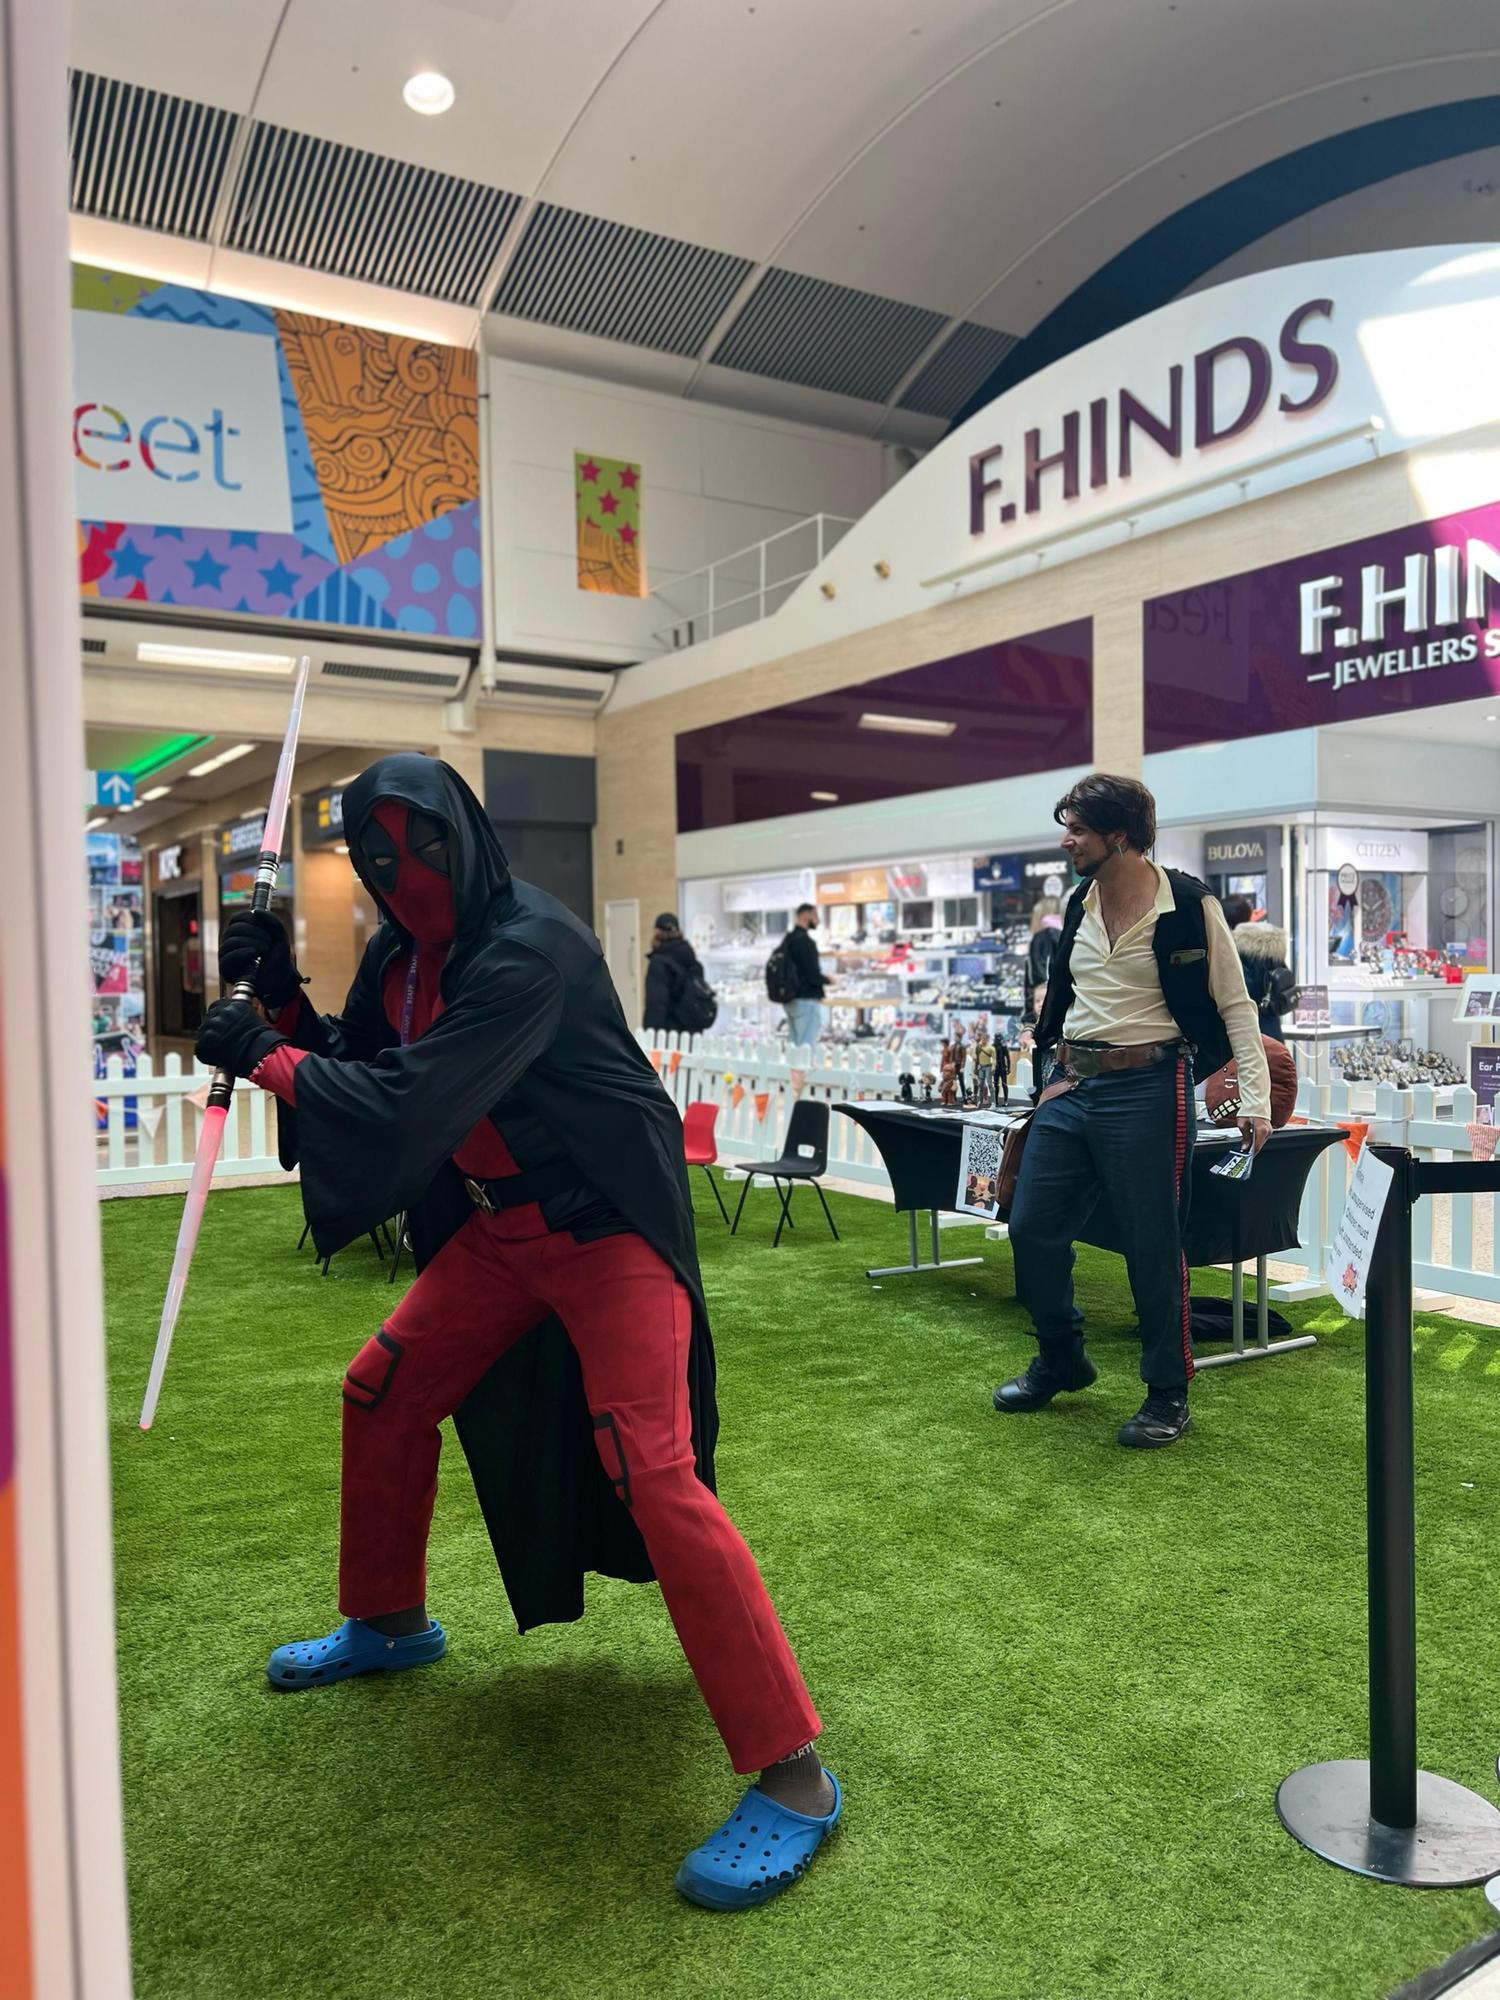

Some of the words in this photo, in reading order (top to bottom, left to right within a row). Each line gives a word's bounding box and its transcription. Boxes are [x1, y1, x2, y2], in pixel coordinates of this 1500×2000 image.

[969, 298, 1339, 536] F.HINDS
[73, 402, 242, 491] eet
[1207, 842, 1265, 861] BULOVA
[1356, 841, 1402, 859] CITIZEN
[778, 1740, 814, 1764] ART
